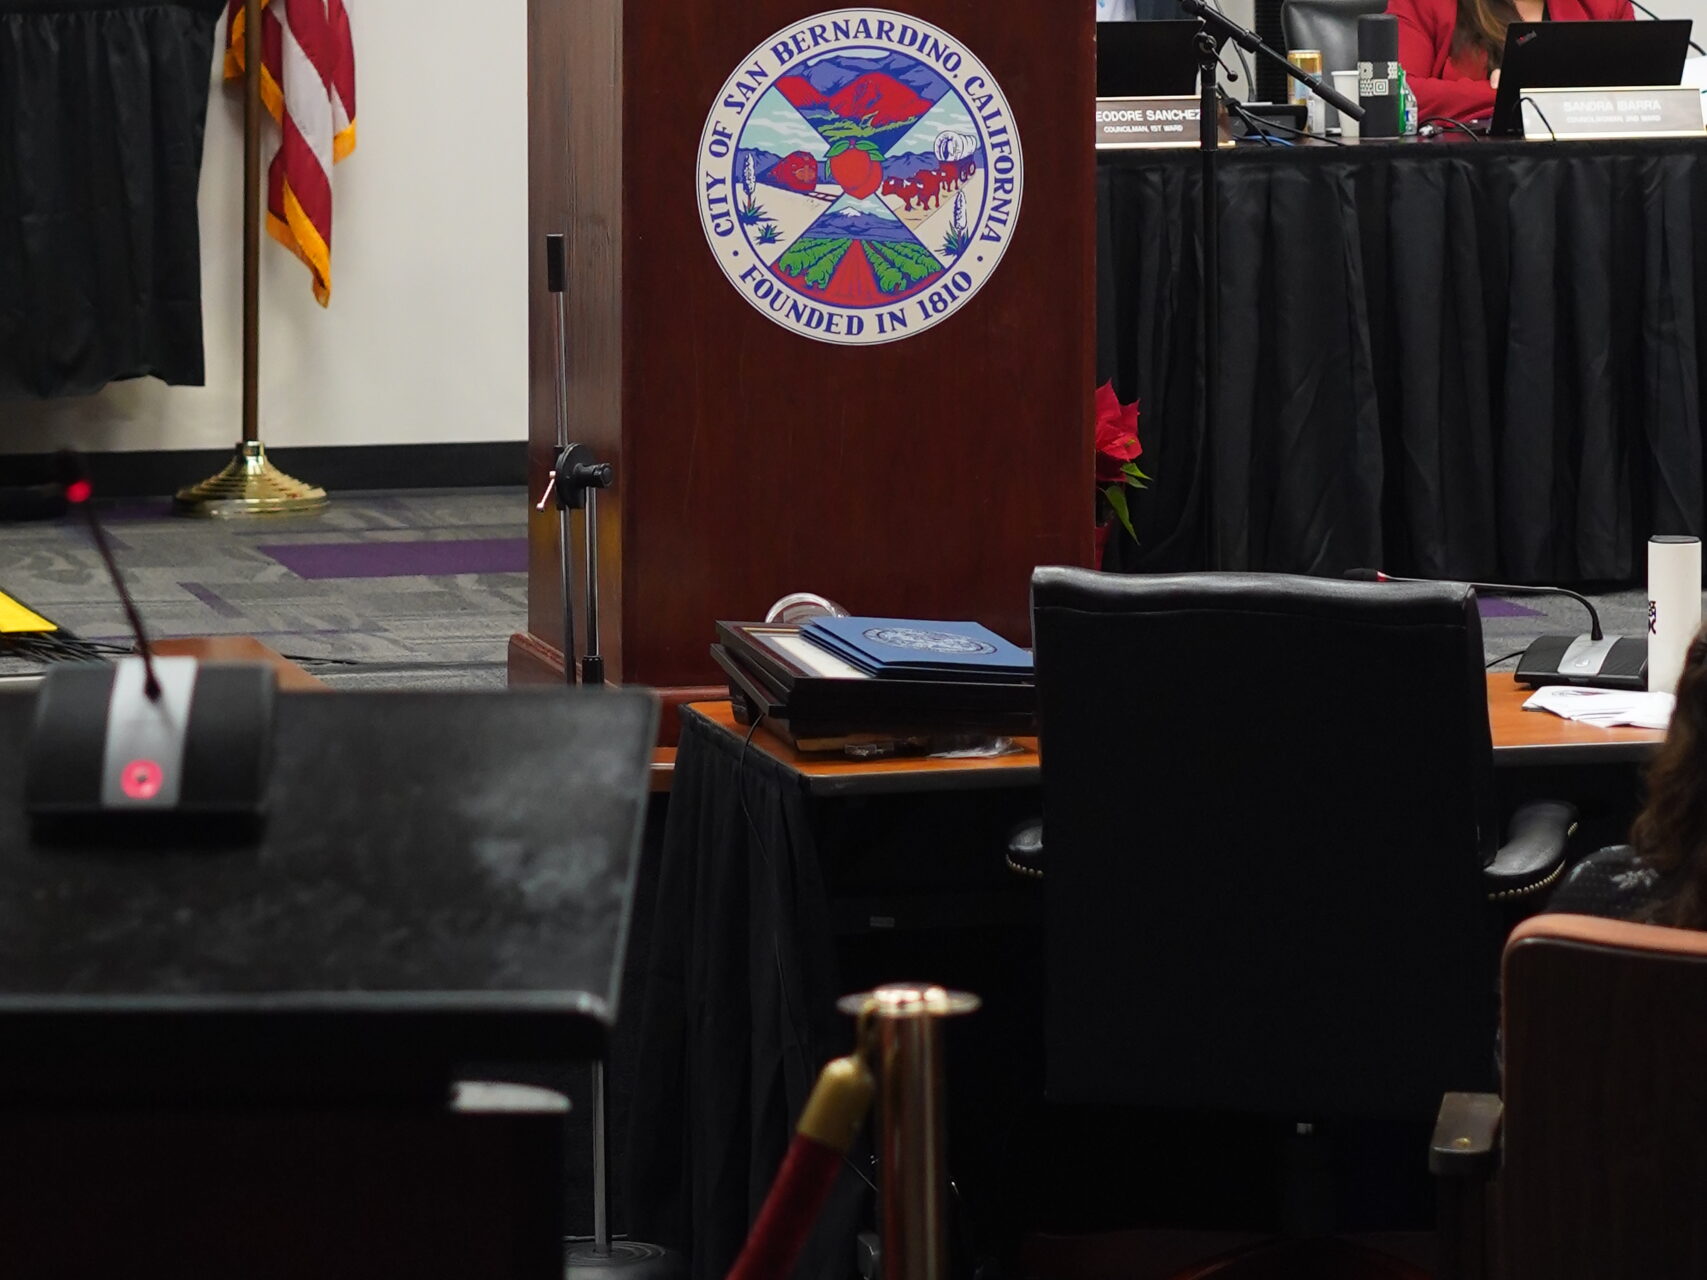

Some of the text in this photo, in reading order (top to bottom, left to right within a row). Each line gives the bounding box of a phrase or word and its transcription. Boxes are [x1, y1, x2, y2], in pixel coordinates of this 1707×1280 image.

[1564, 100, 1662, 112] SANDRA IBARRA
[1146, 109, 1200, 120] SANCHEZ
[706, 18, 1014, 244] CITY OF SAN BERNARDINO, CALIFORNIA
[1163, 124, 1183, 132] WARD
[739, 264, 972, 336] FOUNDED IN 1810
